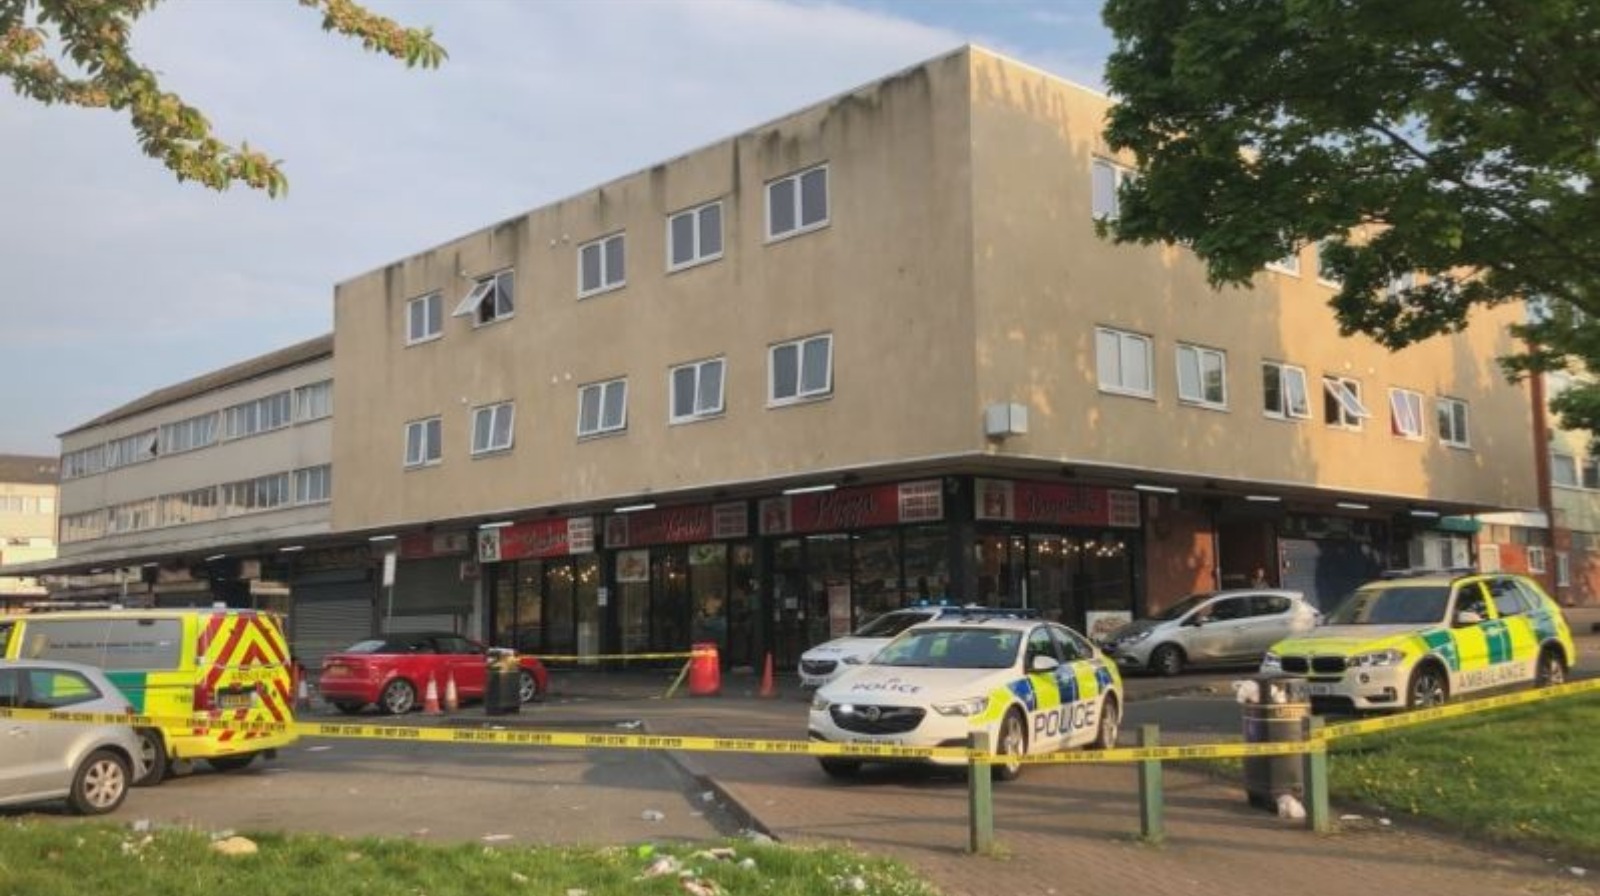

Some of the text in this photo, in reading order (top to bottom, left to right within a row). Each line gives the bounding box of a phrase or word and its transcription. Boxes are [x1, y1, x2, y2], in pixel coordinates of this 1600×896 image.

[1459, 662, 1525, 687] AMBULANCE
[852, 682, 921, 694] POLICE
[1034, 702, 1095, 739] POLICE
